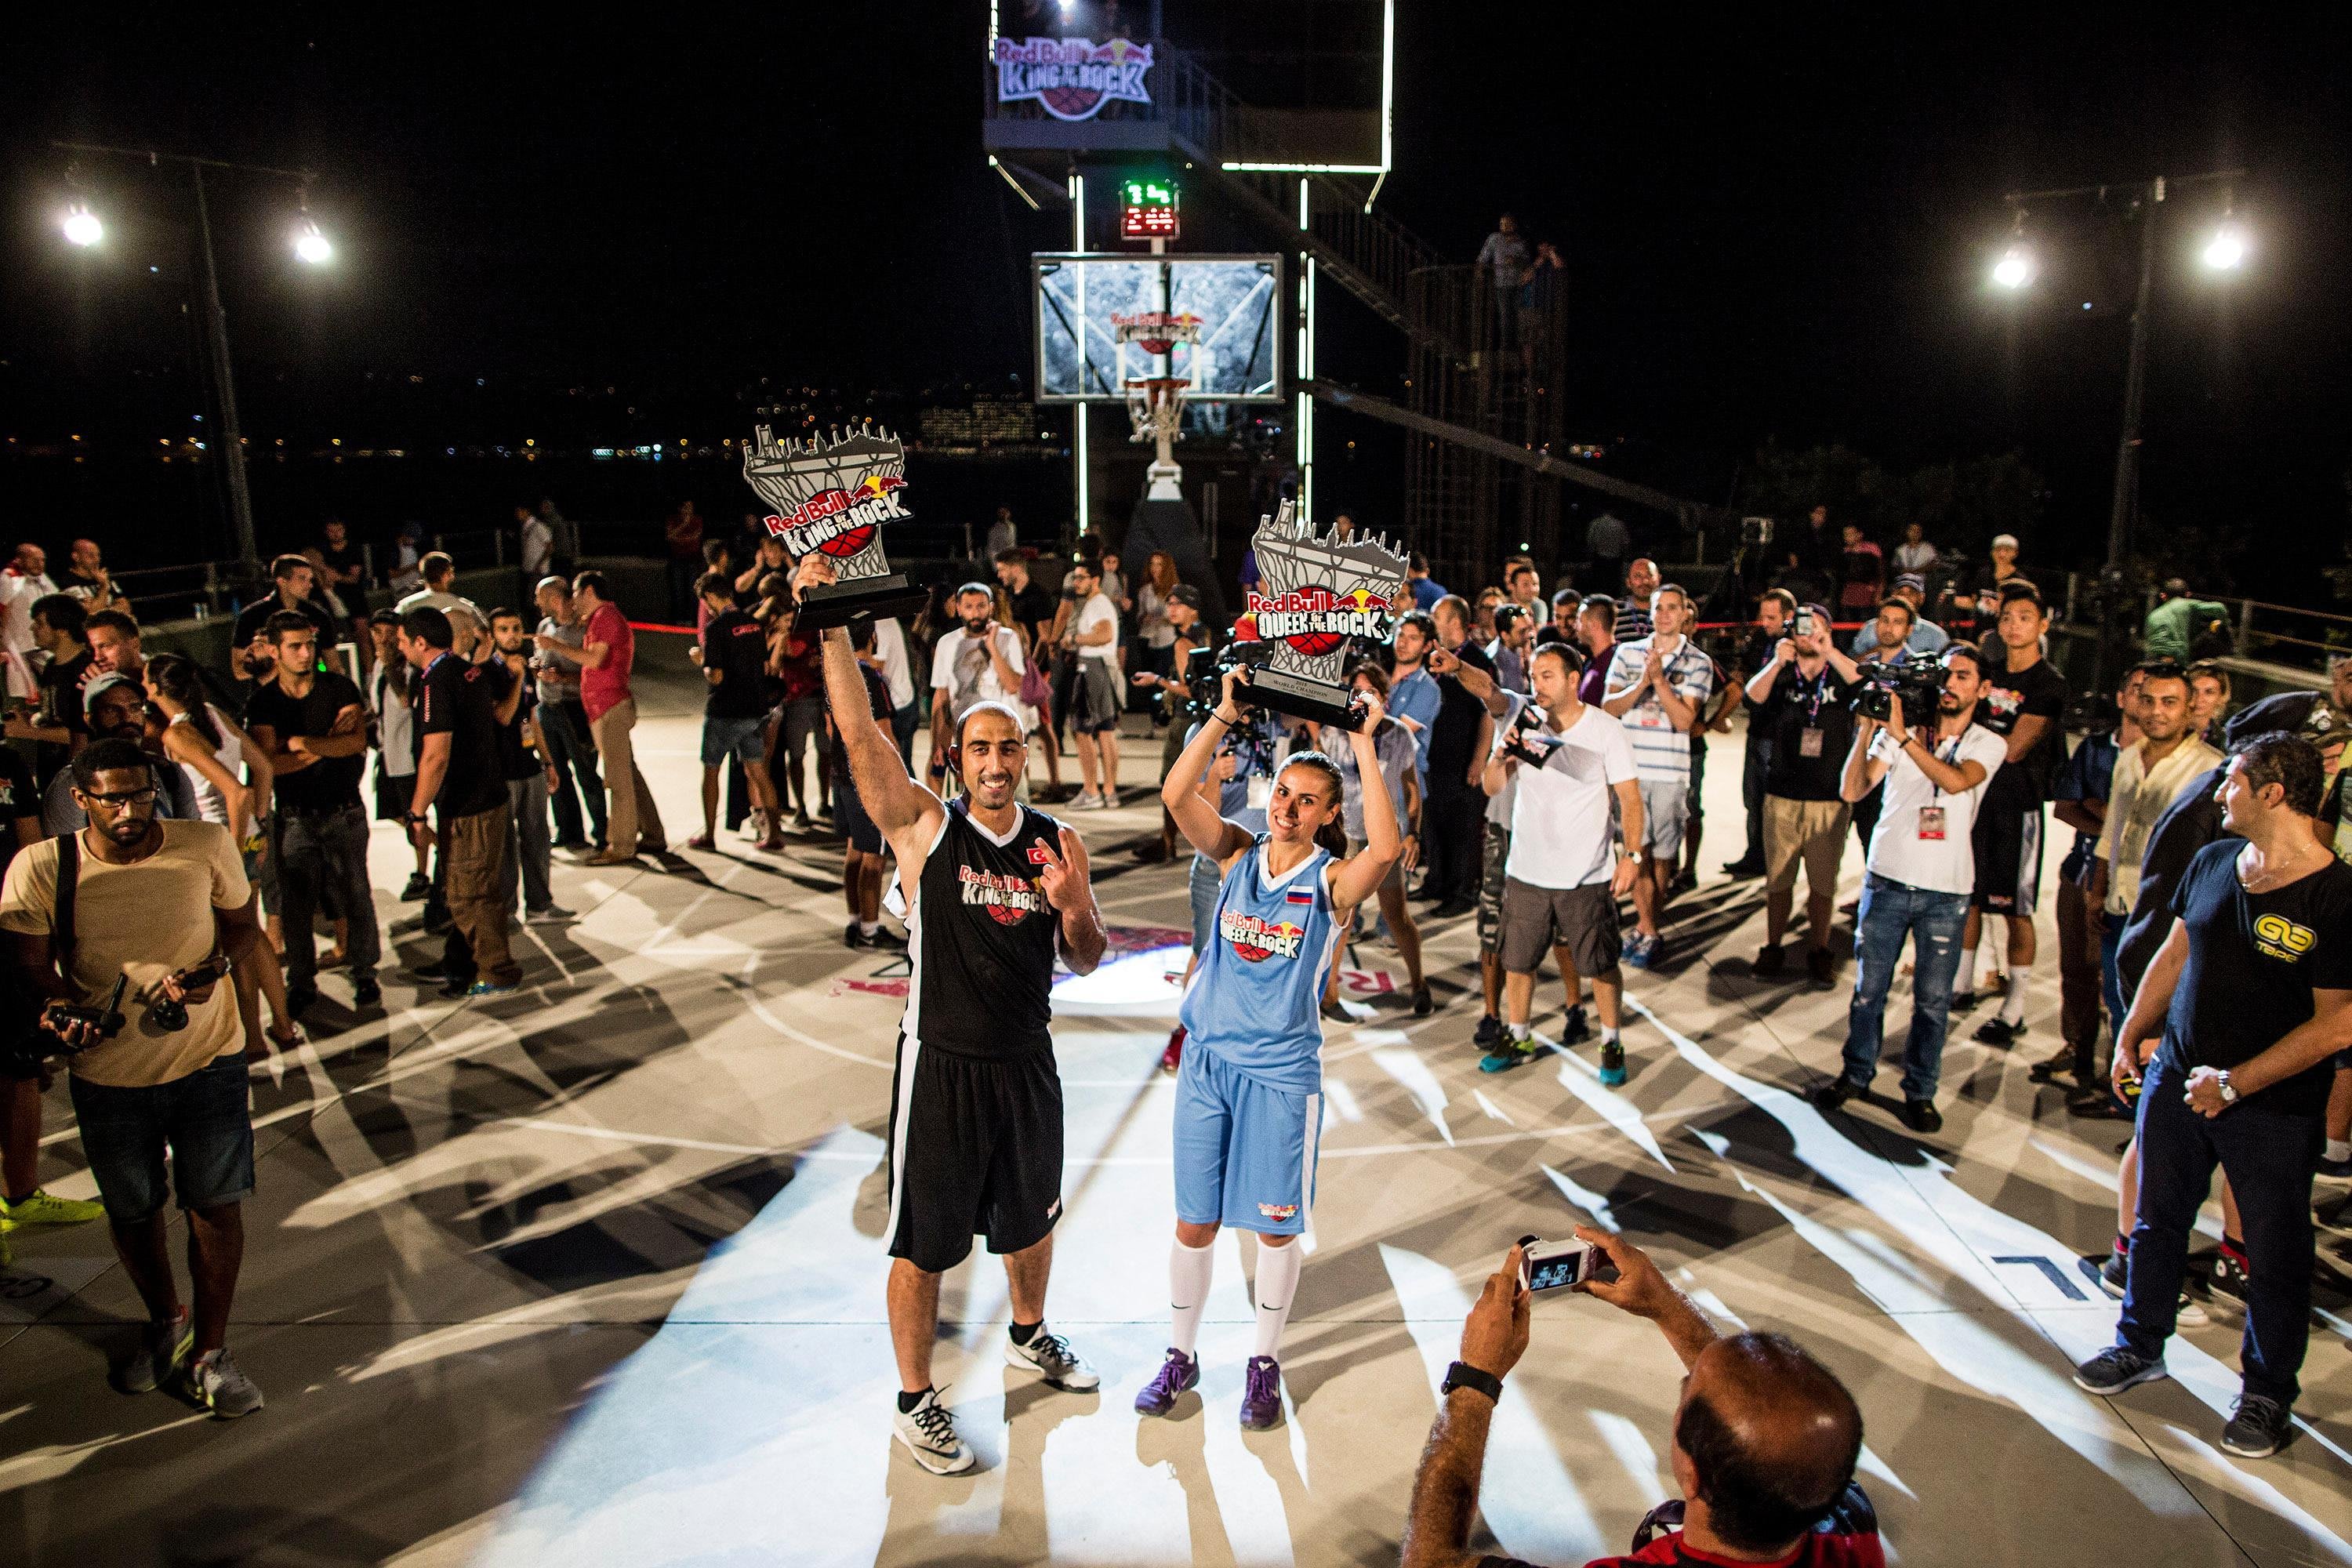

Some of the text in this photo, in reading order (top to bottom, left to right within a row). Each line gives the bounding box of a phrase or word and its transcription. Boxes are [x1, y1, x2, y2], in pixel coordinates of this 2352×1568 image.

[997, 40, 1037, 63] Red
[764, 491, 848, 538] Red Bull
[848, 492, 913, 528] ROCK
[1247, 591, 1327, 613] Red Bull
[1258, 612, 1308, 639] QUEEN
[1308, 622, 1327, 632] THE
[1327, 612, 1384, 639] ROCK
[1273, 680, 1294, 690] WORLD
[1296, 685, 1327, 697] CHAMPION
[959, 865, 1014, 892] Red Bull
[1221, 909, 1261, 933] ed Bull
[1258, 933, 1300, 959] ROCK
